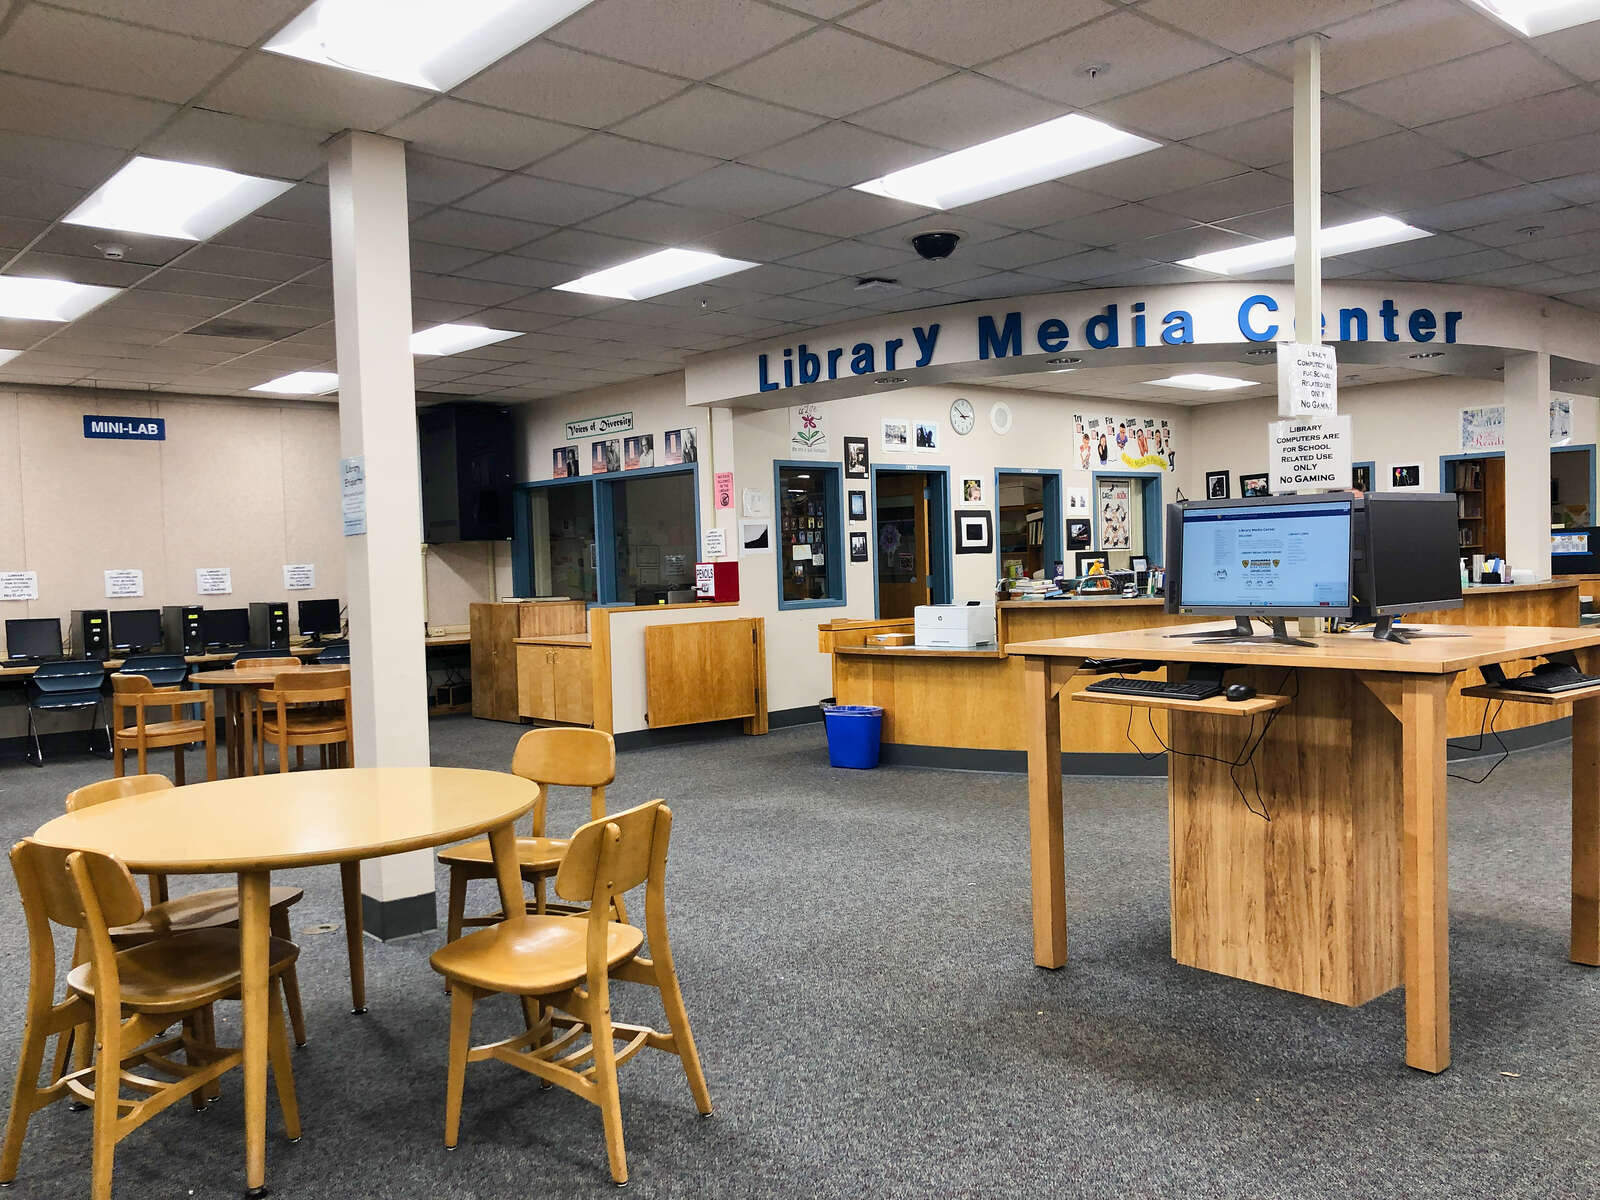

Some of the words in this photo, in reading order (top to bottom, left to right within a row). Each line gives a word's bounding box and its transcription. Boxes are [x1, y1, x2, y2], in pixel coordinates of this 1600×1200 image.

[758, 323, 940, 393] Library
[978, 301, 1195, 360] Media
[1237, 294, 1463, 344] Cnter
[1104, 416, 1114, 425] Fix
[91, 421, 158, 435] MINI-LAB
[568, 424, 589, 436] Voices
[590, 421, 596, 431] of
[599, 416, 632, 432] Diversity
[1289, 424, 1322, 433] LIBRARY
[1276, 434, 1321, 444] COMPUTERS
[1297, 444, 1331, 452] SCHOOL
[1281, 454, 1315, 463] RELATED
[1293, 463, 1318, 472] ONLY
[1280, 476, 1293, 484] NO
[1294, 474, 1336, 483] GAMING
